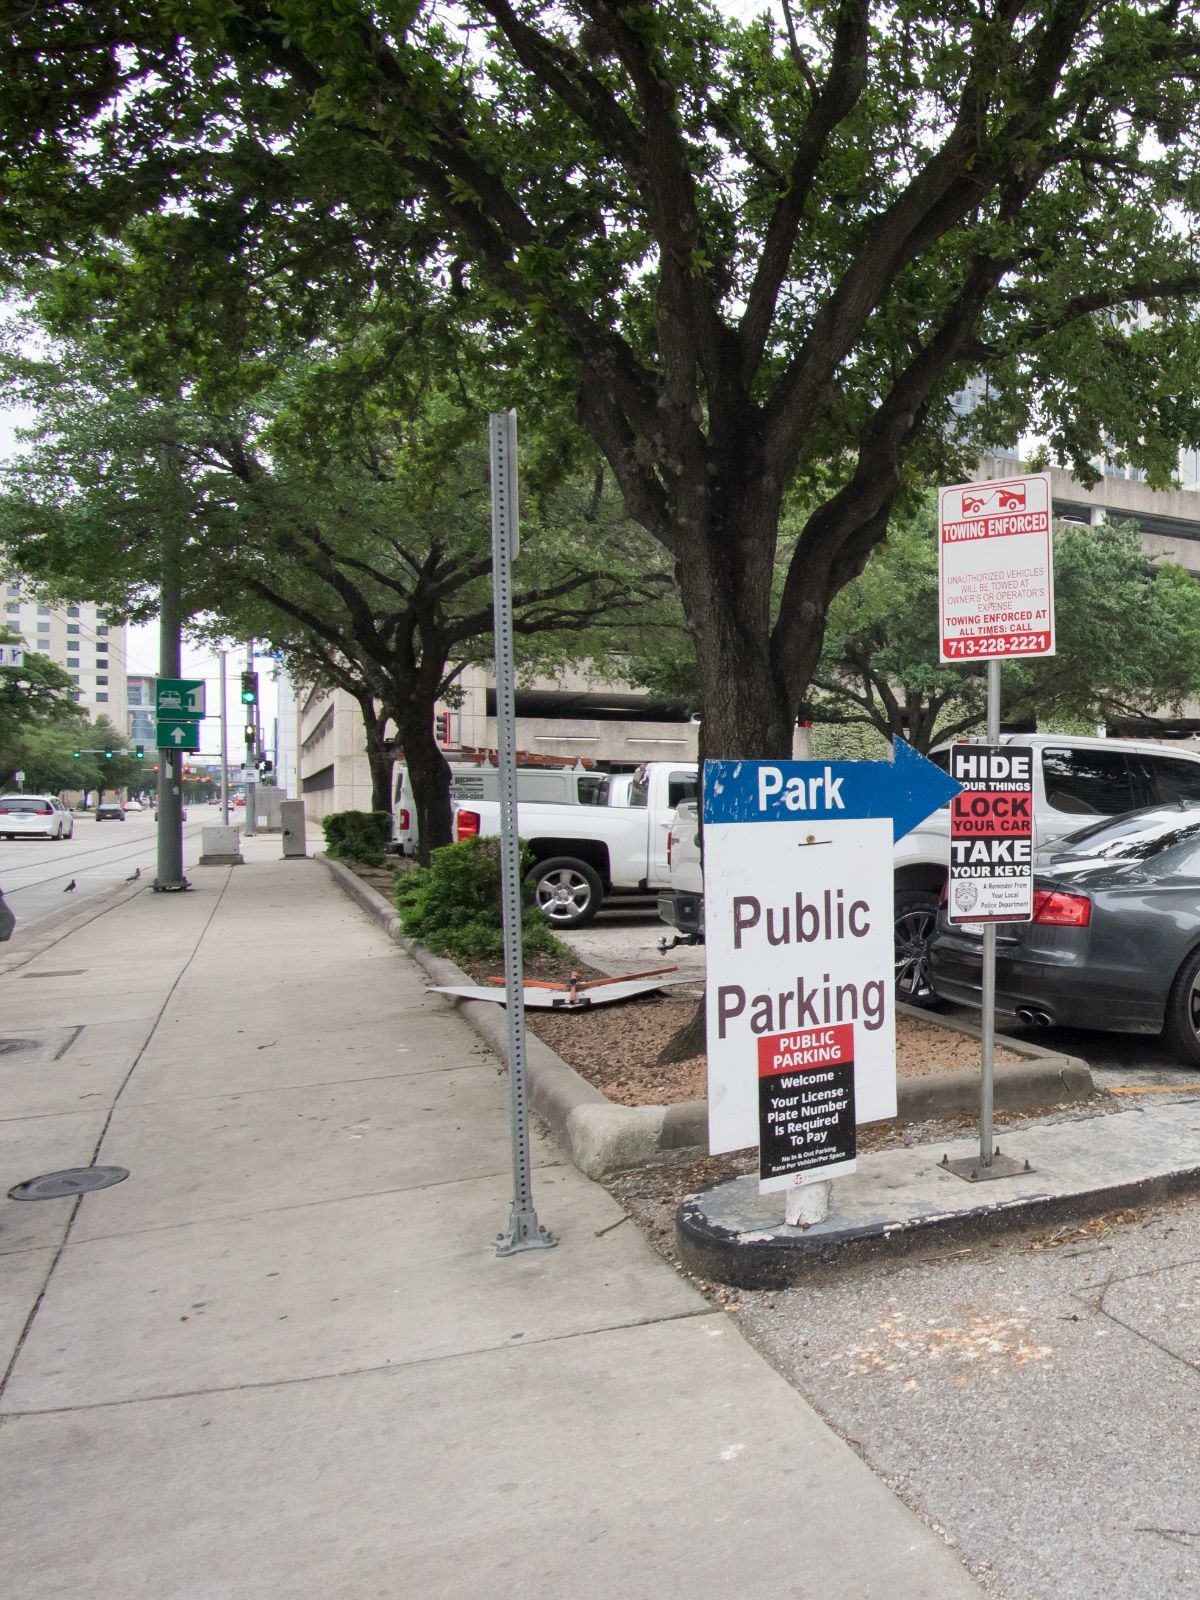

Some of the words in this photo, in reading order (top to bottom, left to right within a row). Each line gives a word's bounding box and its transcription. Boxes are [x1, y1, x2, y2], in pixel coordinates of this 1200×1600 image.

[944, 520, 986, 541] TOWING
[988, 514, 1047, 536] ENFORCED
[948, 571, 1004, 584] UNAUTHORIZED
[1006, 568, 1044, 579] VEHICLES
[948, 594, 982, 605] OWNER'S
[983, 593, 994, 602] OR
[996, 588, 1044, 601] OPERATOR'S
[960, 584, 977, 594] WILL
[980, 583, 988, 592] BE
[992, 581, 1019, 590] TOWED
[1020, 579, 1030, 588] AT
[978, 602, 1012, 613] EXPENSE
[946, 616, 980, 626] TOWING
[984, 612, 1032, 623] ENFORCED
[1036, 610, 1047, 619] AT
[960, 628, 975, 636] ALL
[978, 626, 1007, 635] TIMES:
[1010, 624, 1032, 632] CALL
[949, 635, 1046, 655] 713-228-2221
[956, 756, 1030, 779] HIDE
[758, 766, 845, 812] Park
[989, 782, 1031, 791] THINGS
[955, 797, 1030, 817] LOCK
[953, 820, 995, 831] YOUR
[1000, 820, 1030, 831] CAR
[951, 840, 1031, 863] TAKE
[951, 866, 990, 877] YOUR
[994, 865, 1031, 876] KEYS
[998, 901, 1028, 909] Department
[732, 888, 871, 950] Public
[717, 974, 886, 1040] Parking
[780, 1030, 835, 1052] PUBLIC
[773, 1046, 841, 1069] PARKING
[781, 1072, 834, 1089] Welcome
[771, 1096, 799, 1109] Your
[802, 1087, 844, 1104] License
[768, 1110, 798, 1123] Plate
[801, 1100, 848, 1117] Number
[775, 1126, 784, 1136] Is
[788, 1112, 839, 1134] Required
[790, 1136, 804, 1146] To
[806, 1131, 828, 1143] Pay
